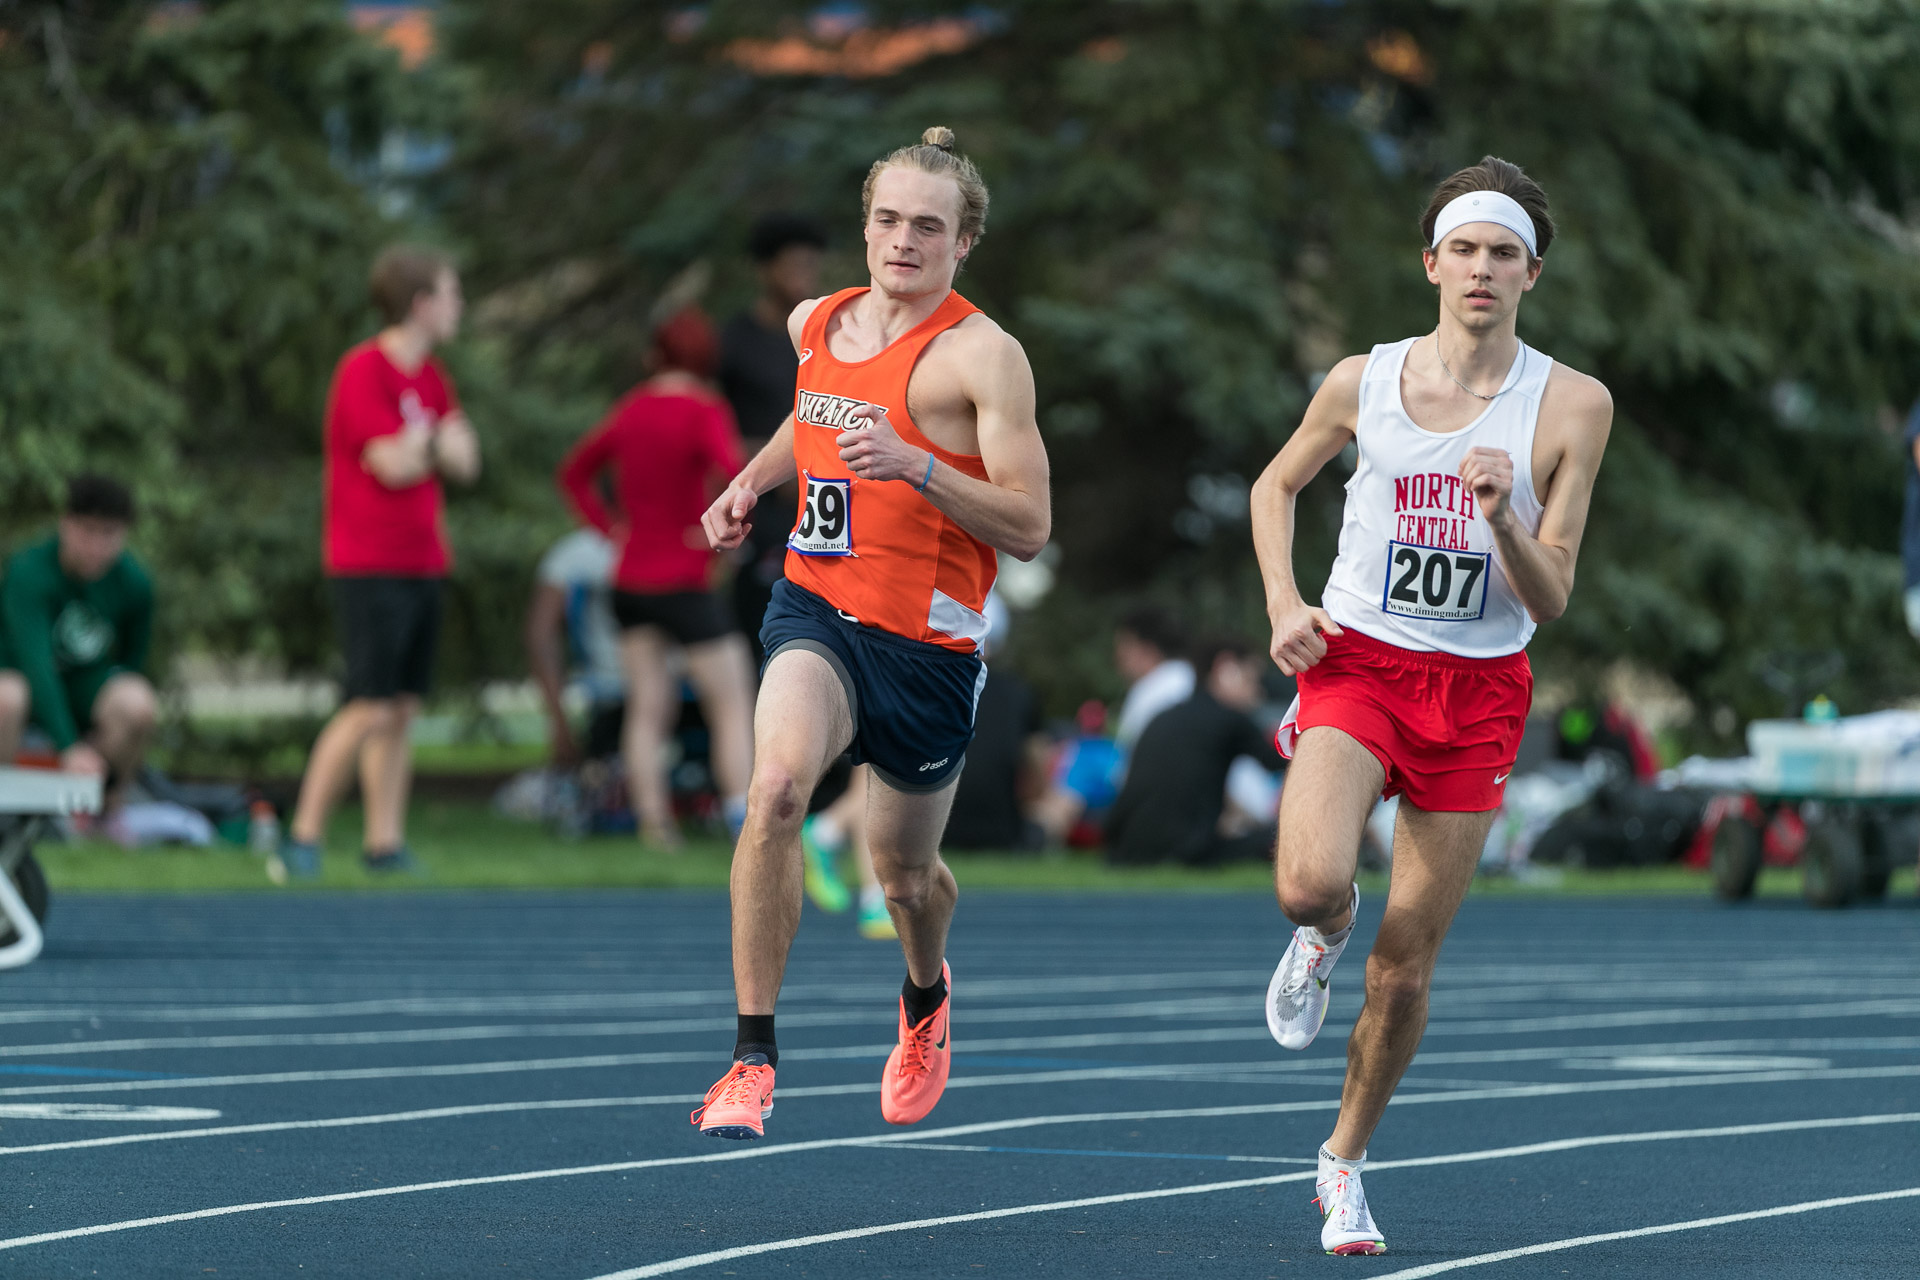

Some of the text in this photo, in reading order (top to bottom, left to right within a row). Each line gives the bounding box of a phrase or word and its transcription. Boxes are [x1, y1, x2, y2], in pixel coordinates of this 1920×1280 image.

[1394, 473, 1475, 520] NORTH
[1396, 514, 1469, 550] CENTRAL
[1389, 548, 1485, 608] 207
